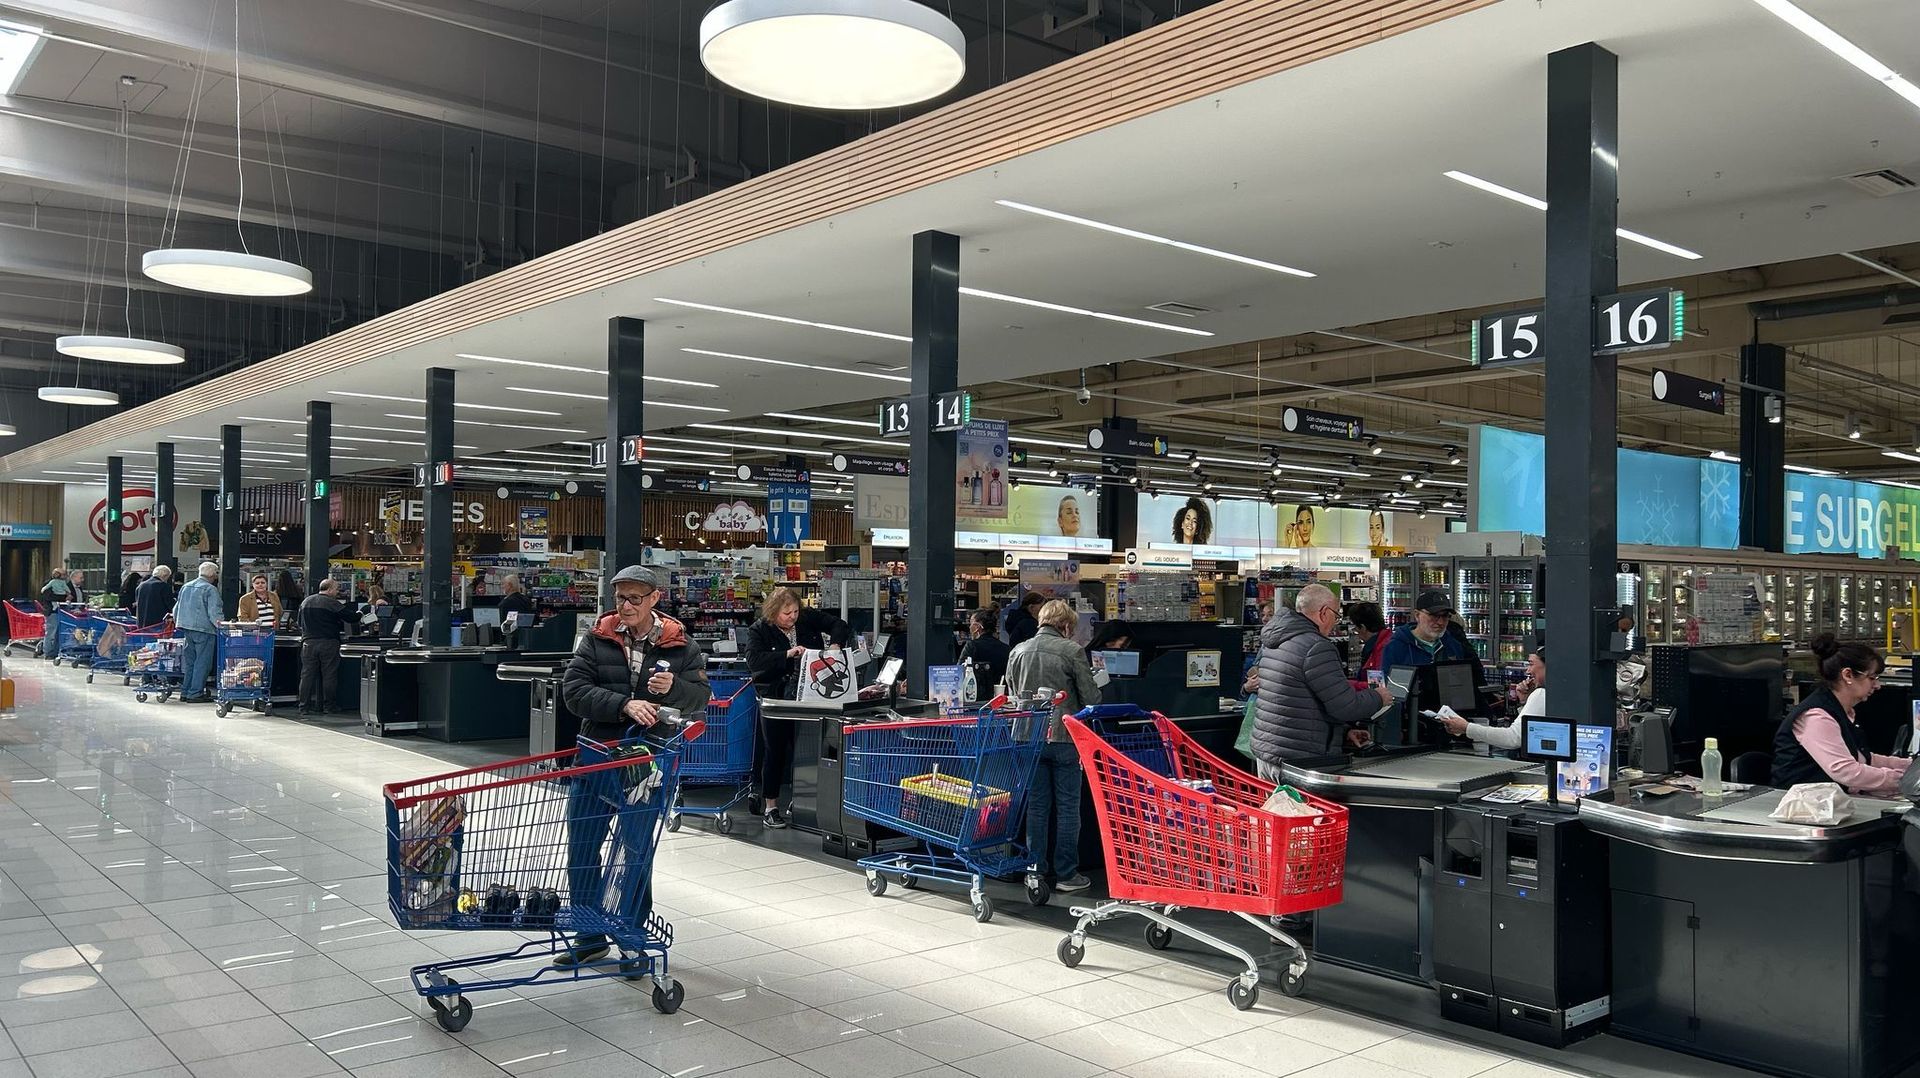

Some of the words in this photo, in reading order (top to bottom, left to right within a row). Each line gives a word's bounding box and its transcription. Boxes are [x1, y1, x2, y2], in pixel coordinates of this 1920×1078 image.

[1602, 297, 1659, 347] 16
[1486, 314, 1539, 361] 15
[886, 402, 910, 432] 13
[935, 396, 961, 427] 14
[595, 442, 607, 464] 11
[622, 440, 636, 462] 12
[419, 467, 425, 484] 9
[435, 464, 445, 482] 10
[788, 486, 795, 494] le
[795, 487, 808, 496] prix
[379, 498, 485, 523] IEES
[865, 494, 908, 523] Esp
[13, 527, 51, 536] SANITAIRES
[719, 520, 748, 530] baby
